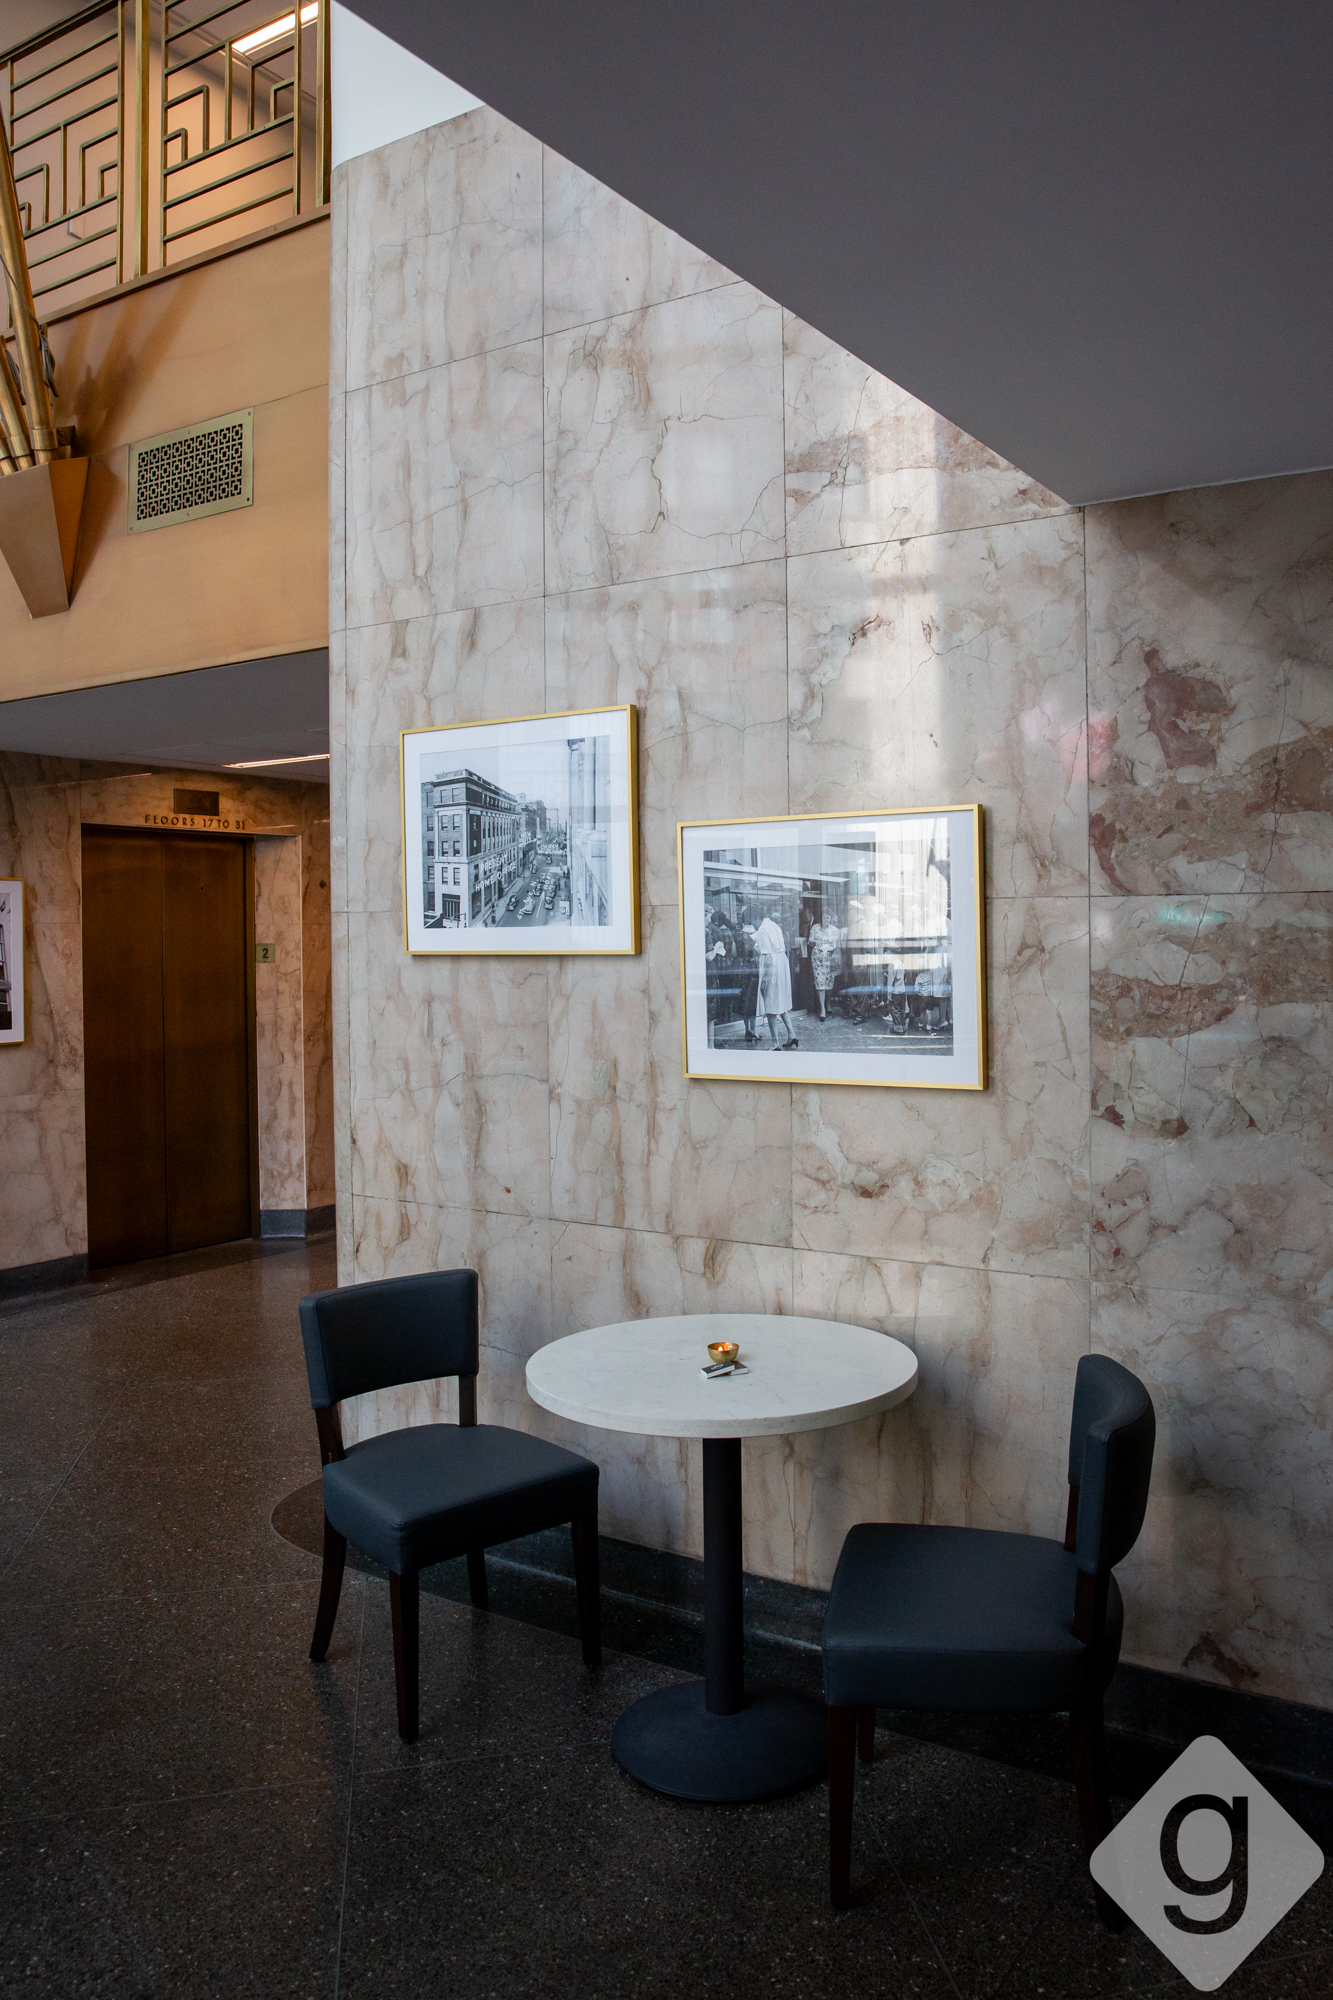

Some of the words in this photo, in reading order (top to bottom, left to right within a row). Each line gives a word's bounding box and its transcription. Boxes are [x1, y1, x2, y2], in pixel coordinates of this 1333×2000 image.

[145, 814, 195, 826] FLOORS
[203, 819, 214, 828] 17
[217, 819, 229, 829] TO
[235, 820, 245, 830] 31
[481, 853, 508, 873] PRESENT
[476, 875, 494, 892] HOME
[497, 861, 517, 880] OFFICE
[262, 947, 269, 959] 2
